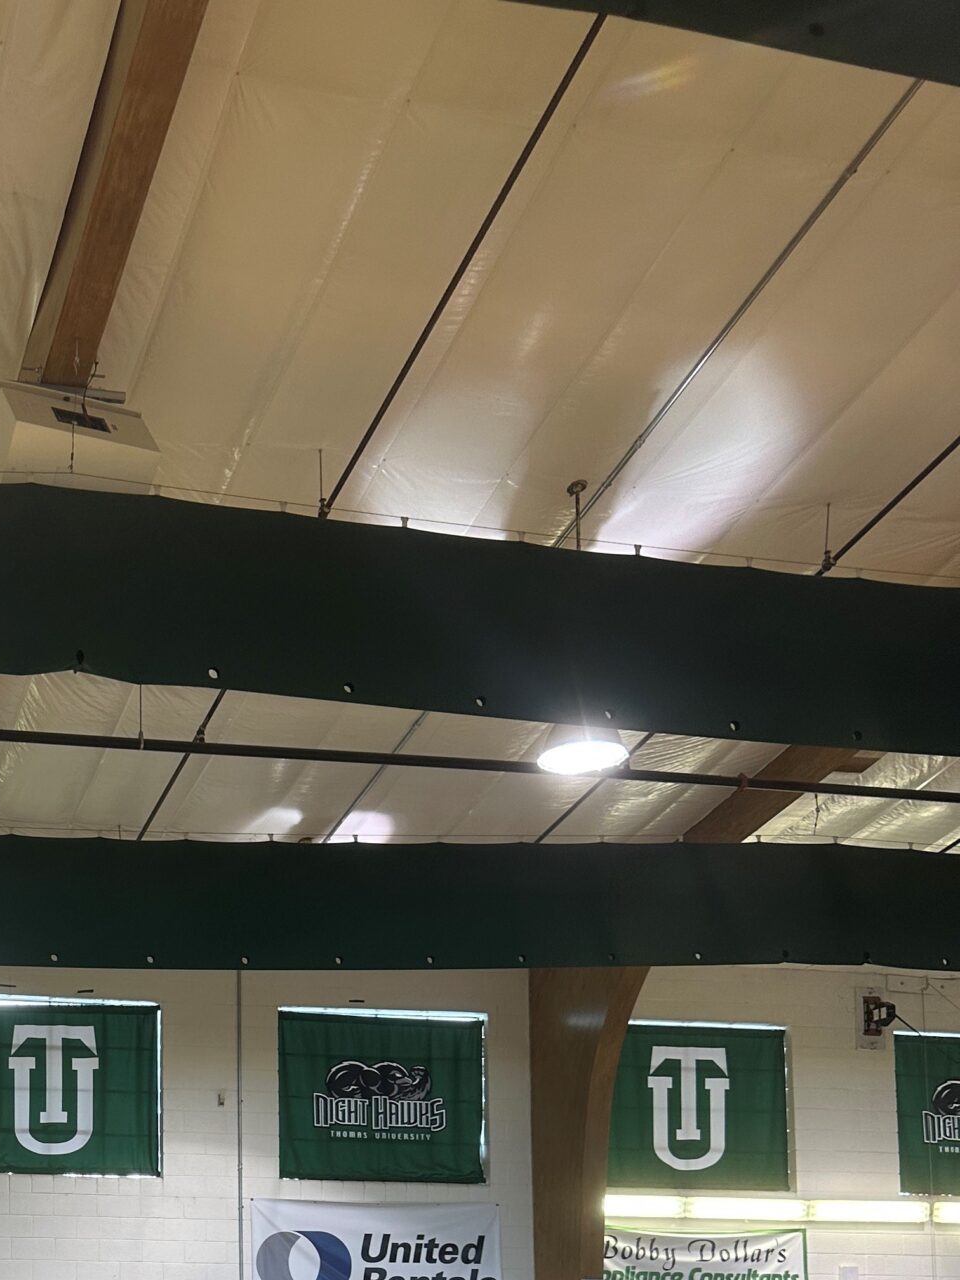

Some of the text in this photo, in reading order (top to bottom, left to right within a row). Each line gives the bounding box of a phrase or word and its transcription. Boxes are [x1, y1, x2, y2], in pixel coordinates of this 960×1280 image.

[313, 1092, 446, 1132] NIGHT HAWKS
[330, 1130, 431, 1141] THOMAS UNIVERSITY
[360, 1233, 486, 1265] United
[604, 1234, 676, 1271] Bobby
